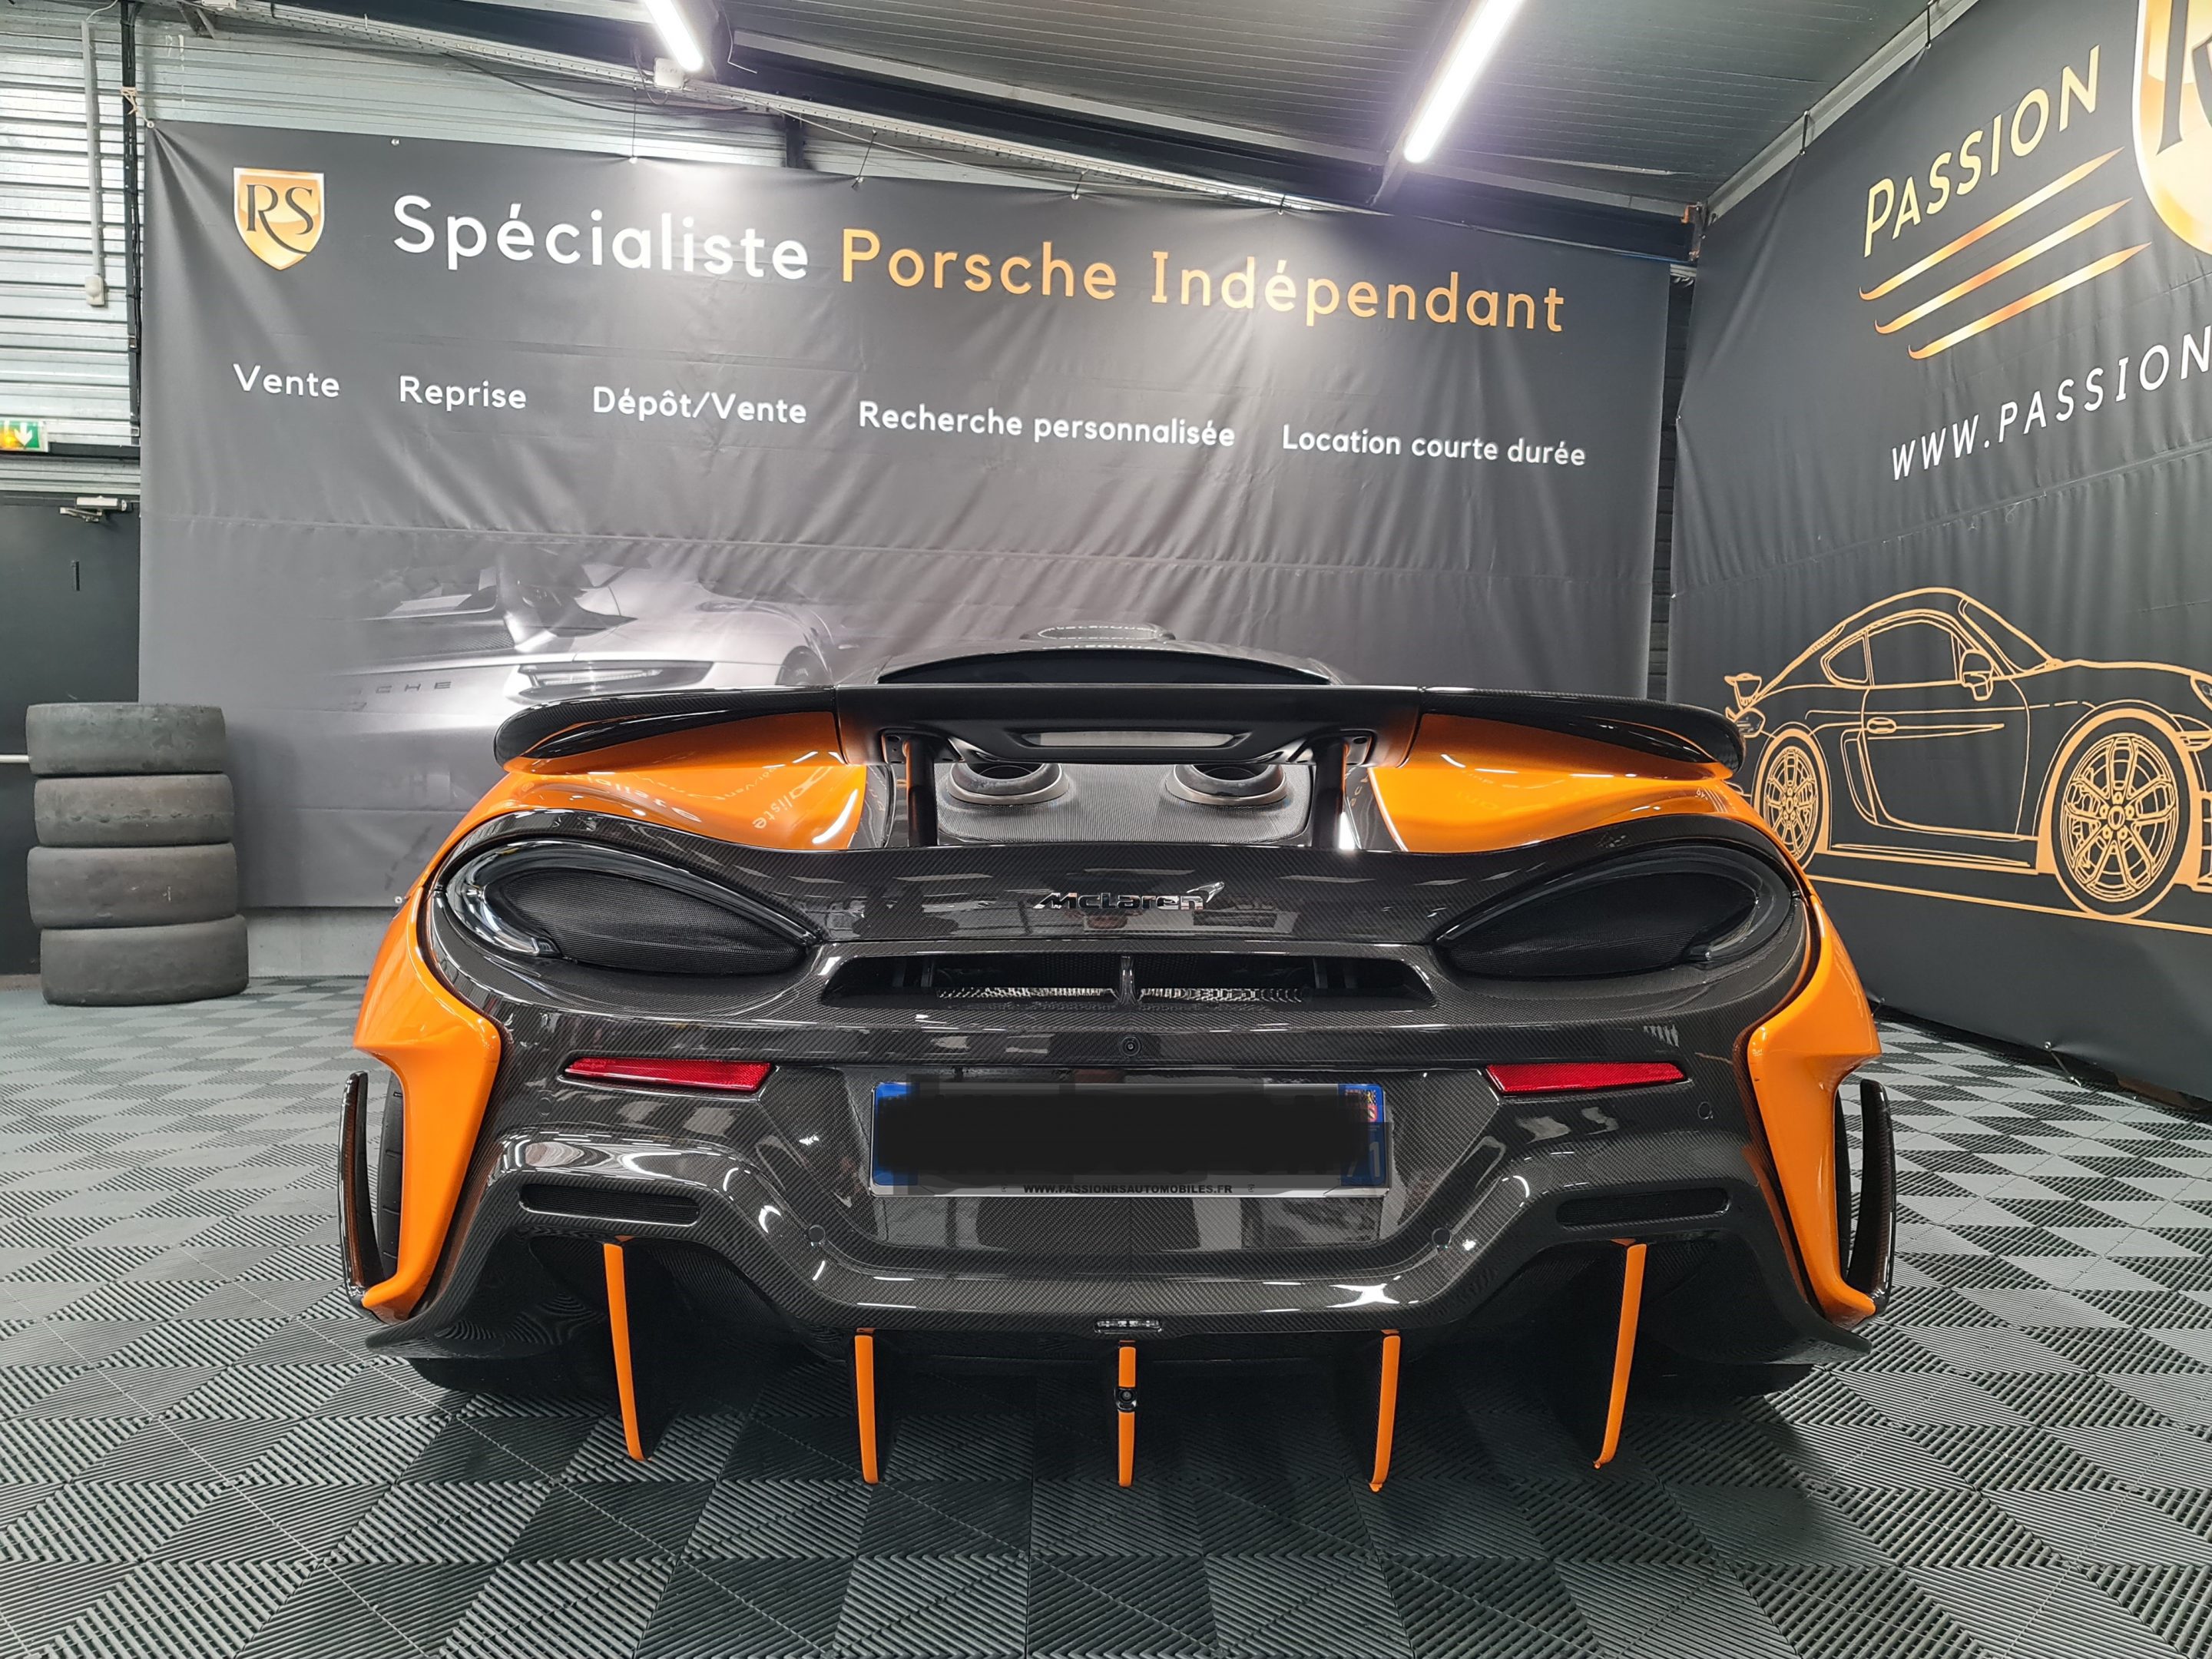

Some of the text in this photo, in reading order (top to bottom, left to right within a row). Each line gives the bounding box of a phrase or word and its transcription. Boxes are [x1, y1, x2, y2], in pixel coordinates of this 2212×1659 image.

[1864, 45, 2100, 257] PASSION
[246, 184, 315, 254] RS
[393, 194, 1565, 333] Spécialiste Porsche Indépendant
[233, 363, 340, 398] Vente
[399, 375, 528, 411] Reprise
[593, 386, 807, 422] Dépôt/Vente
[1891, 324, 2211, 481] WWW.PASSION
[859, 400, 1236, 448] Recherche personnalisée
[1283, 424, 1586, 466] Location courte durée
[1032, 892, 1204, 910] McLaren
[1023, 1184, 1233, 1194] WWW.PASSIONRSAUTOMOBILES.FR
